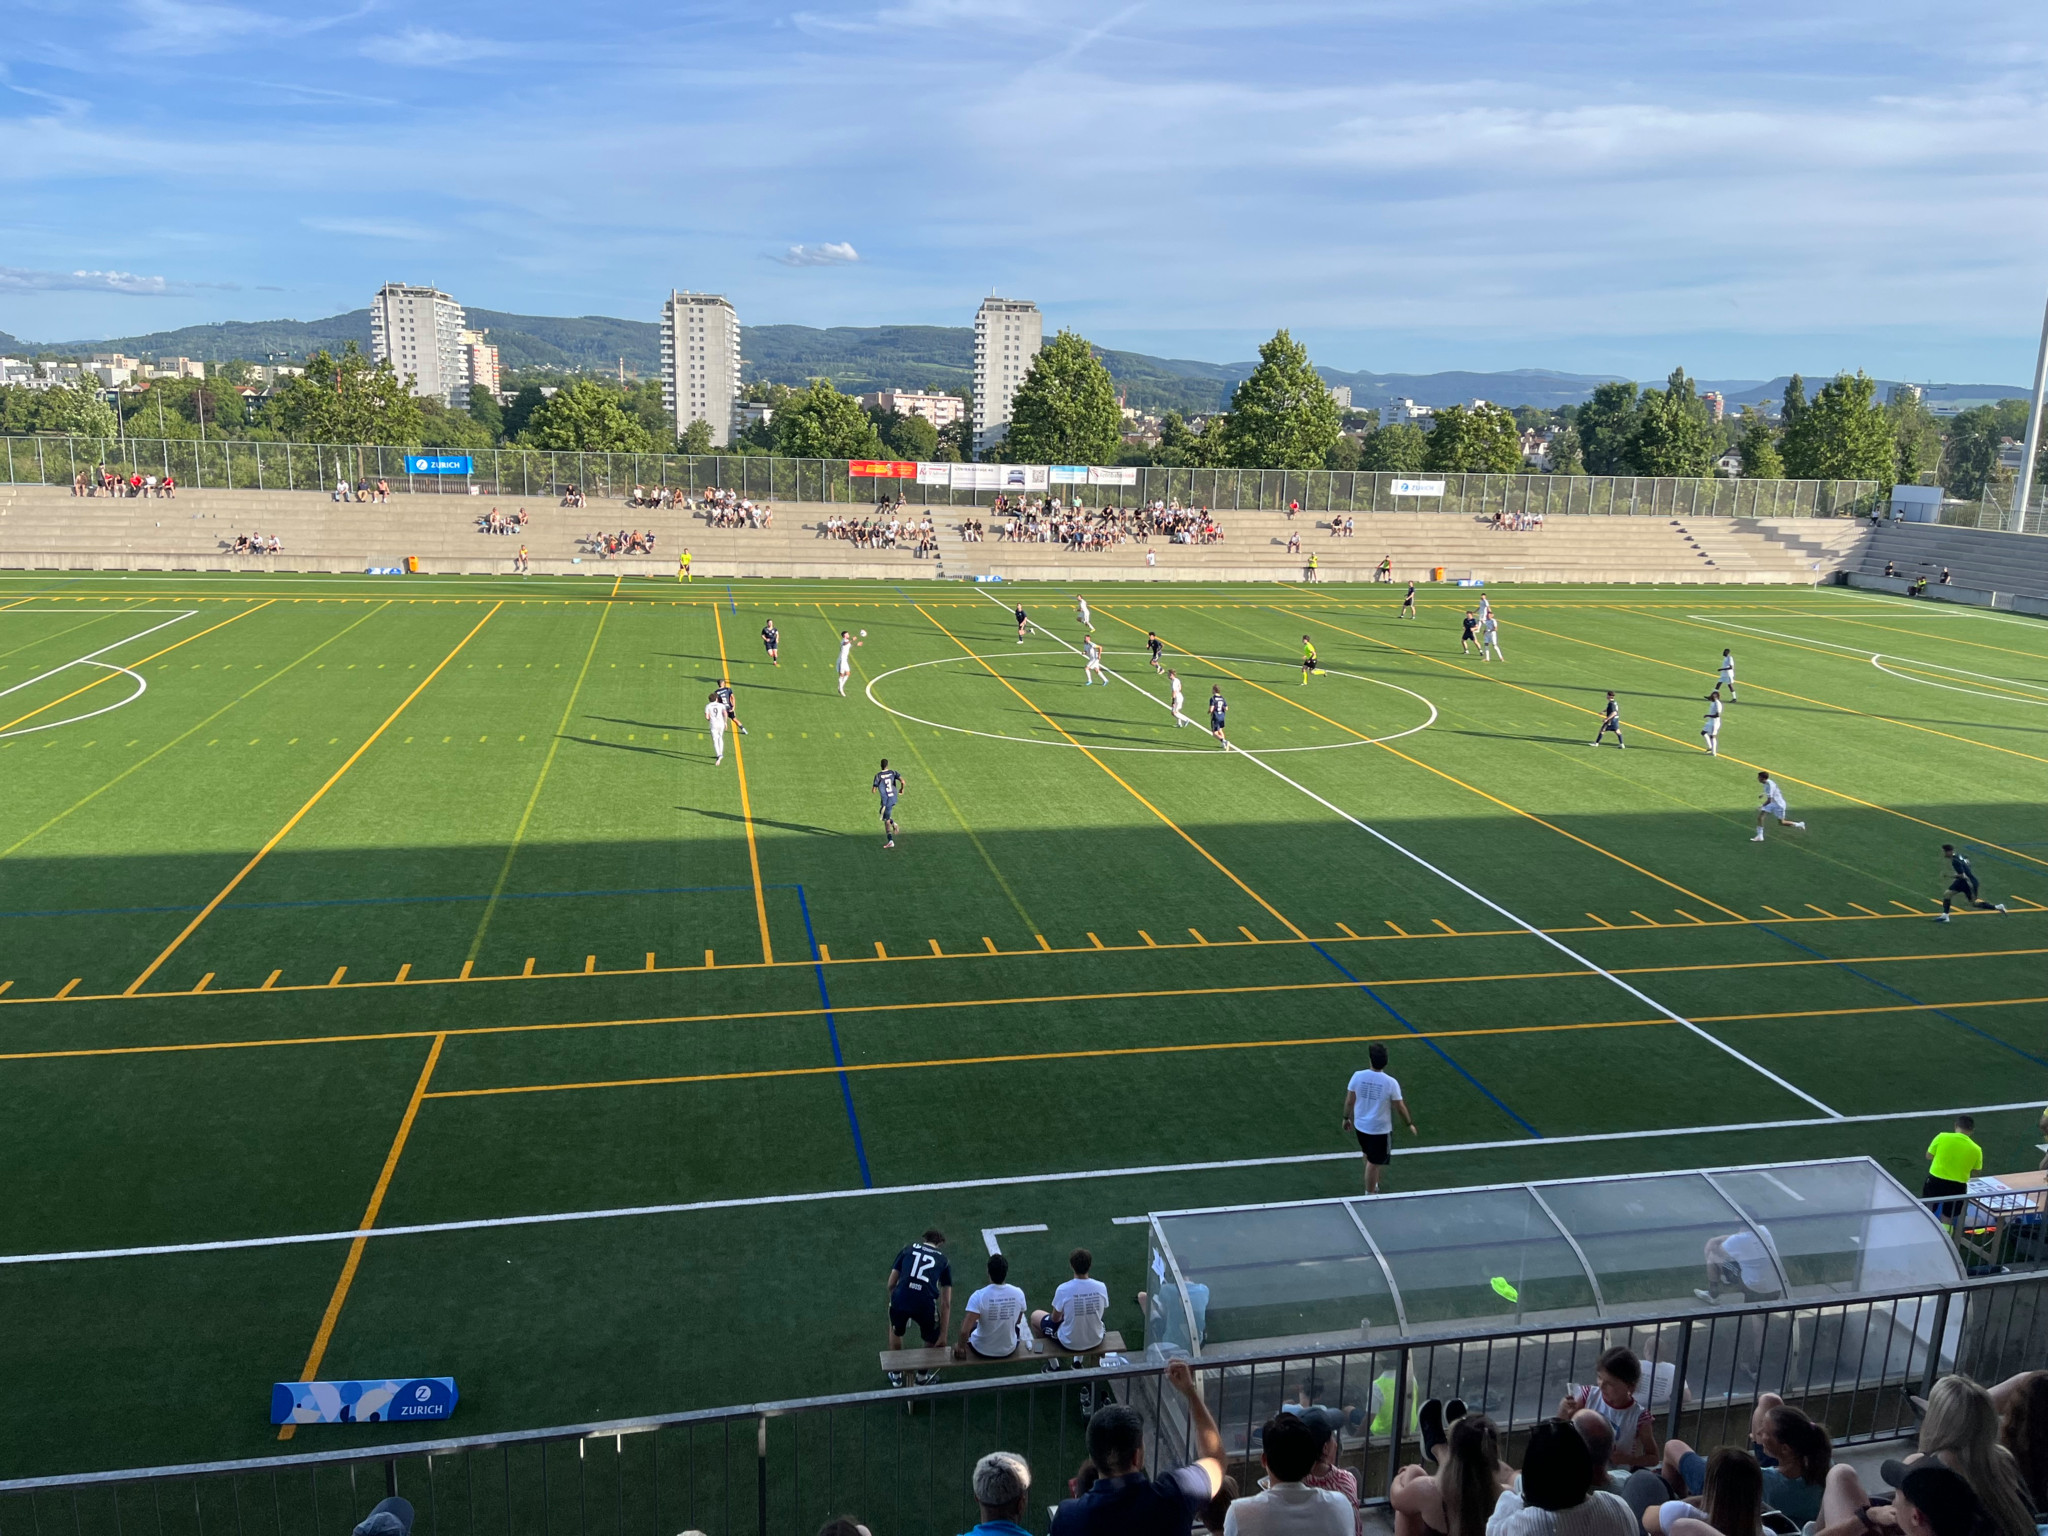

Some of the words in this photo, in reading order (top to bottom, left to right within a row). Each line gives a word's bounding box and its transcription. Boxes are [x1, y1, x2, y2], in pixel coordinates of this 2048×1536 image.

[430, 461, 460, 469] ZURICH
[713, 707, 718, 717] 9
[884, 778, 893, 793] 3
[910, 1250, 936, 1283] 12
[401, 1404, 443, 1416] ZURICH
